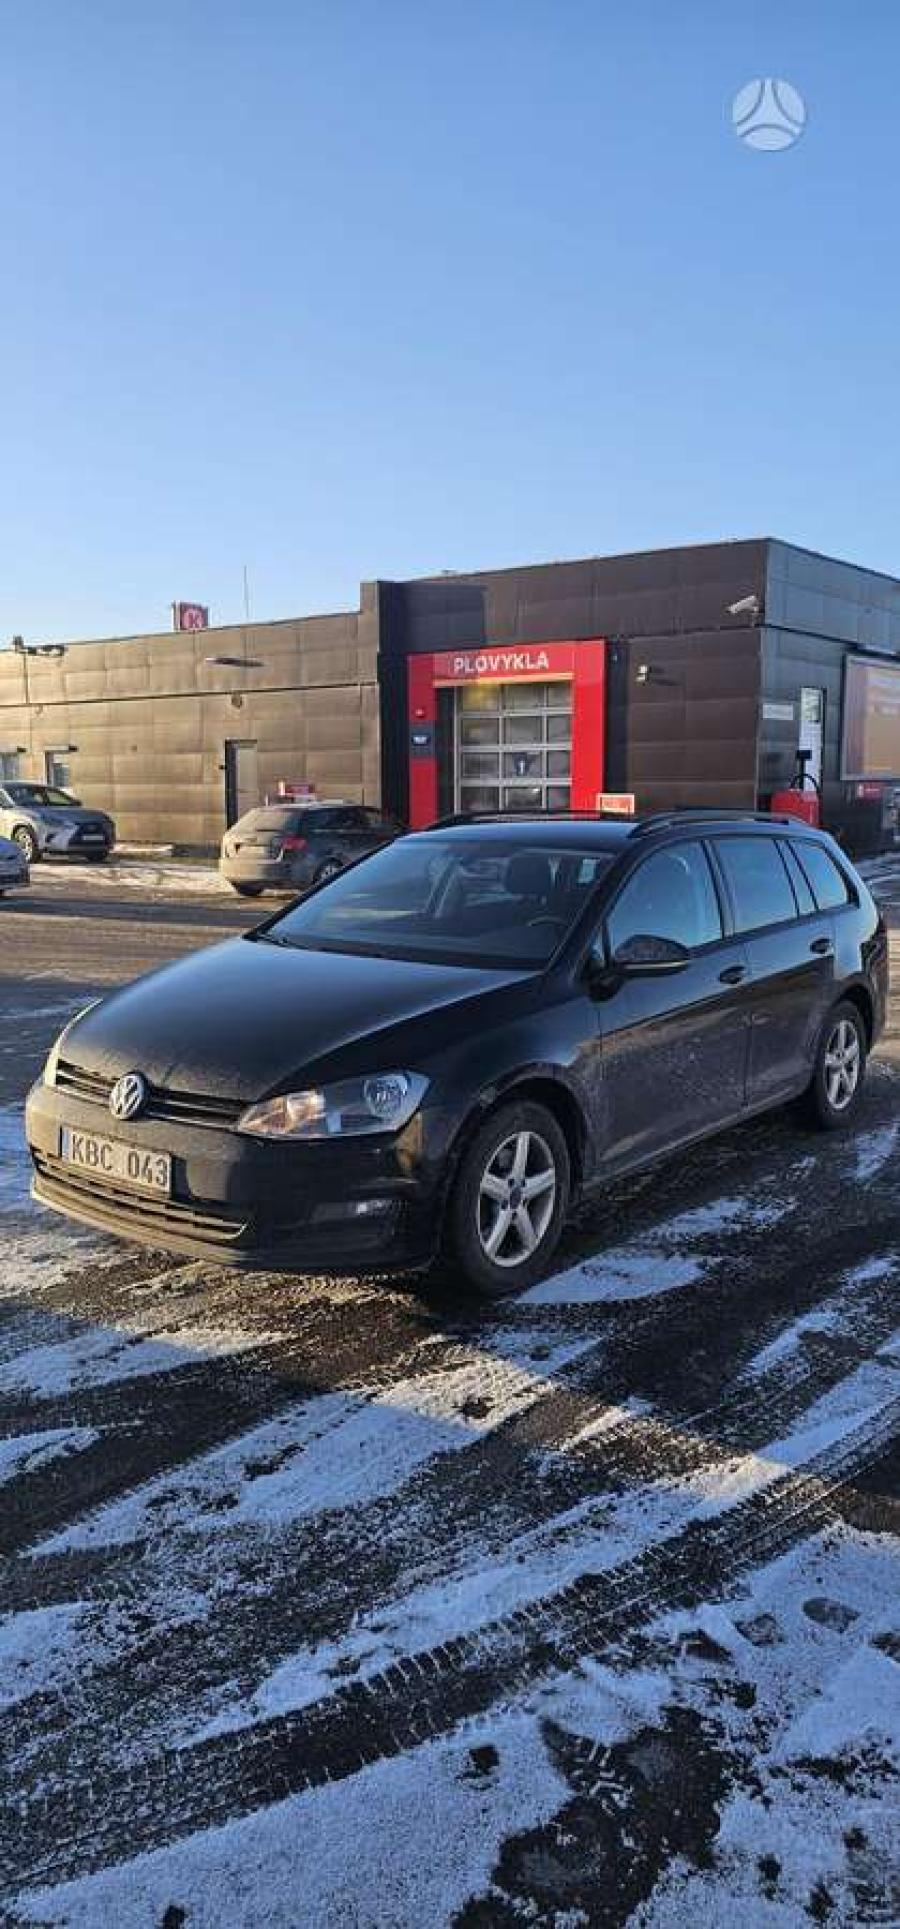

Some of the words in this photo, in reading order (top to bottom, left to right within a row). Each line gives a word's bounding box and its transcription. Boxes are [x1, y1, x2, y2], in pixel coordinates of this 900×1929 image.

[453, 651, 549, 674] PLOVYKLA
[72, 1133, 112, 1171] KBC
[127, 1151, 168, 1186] 043
